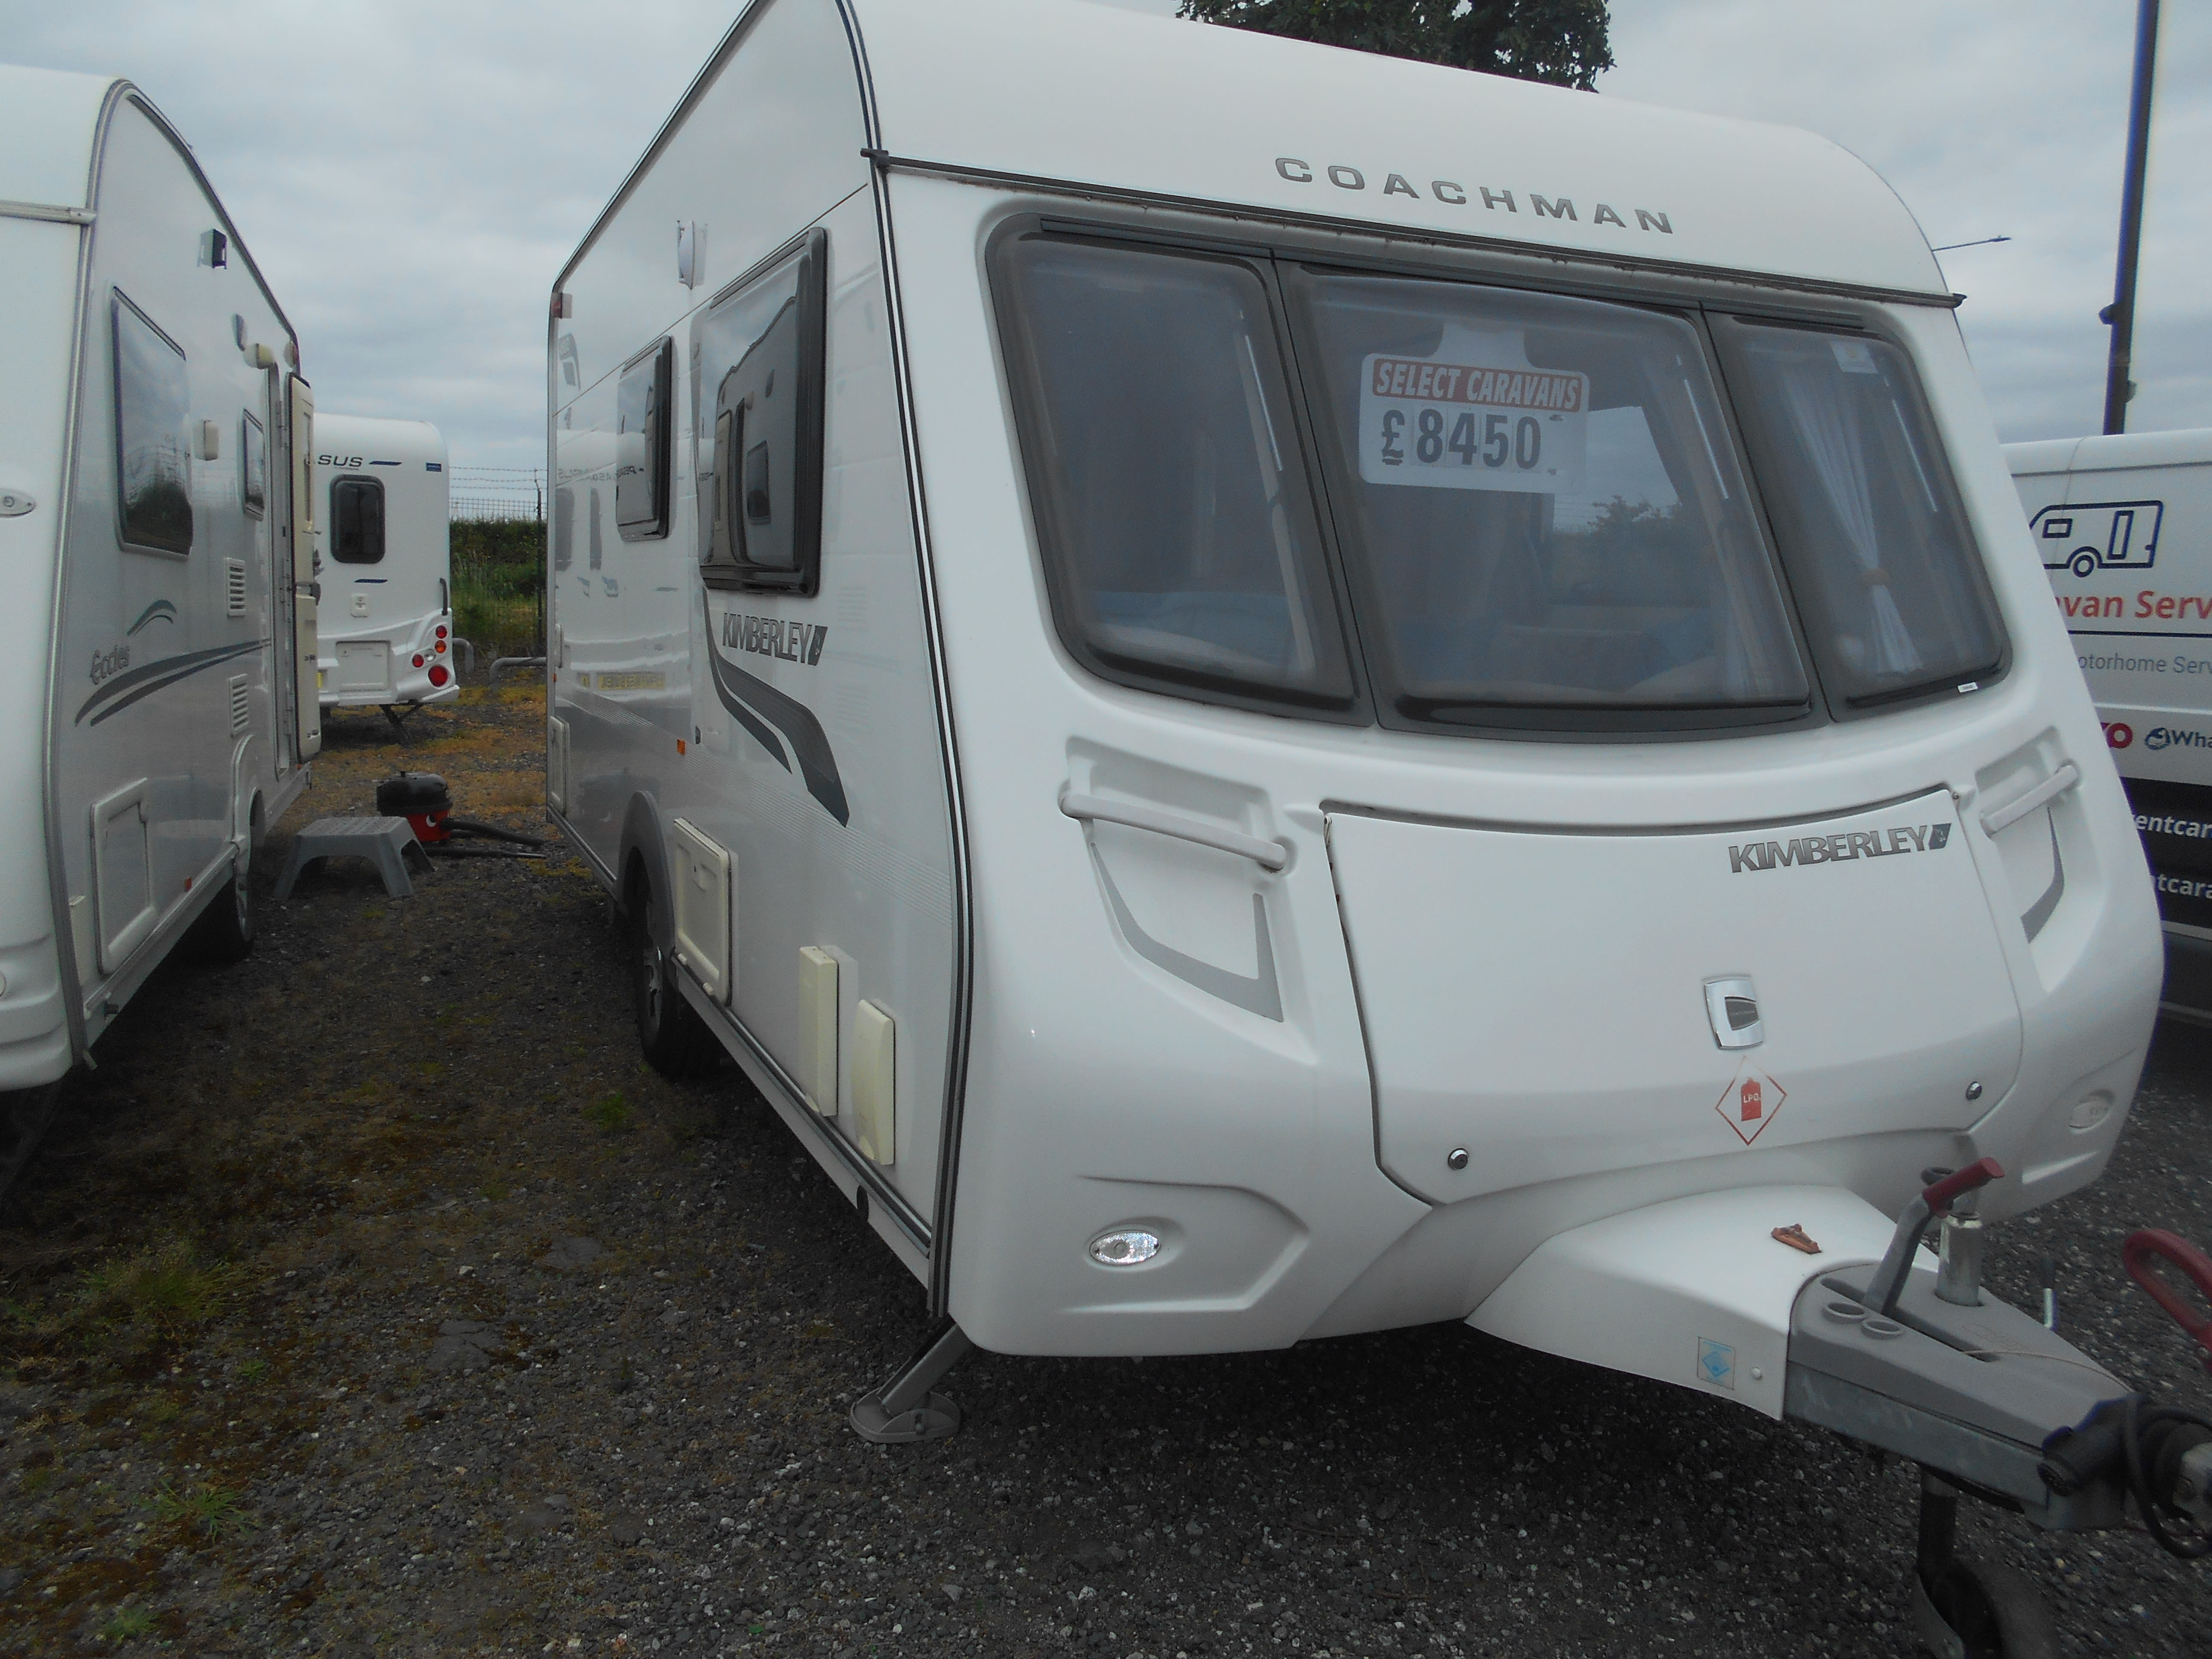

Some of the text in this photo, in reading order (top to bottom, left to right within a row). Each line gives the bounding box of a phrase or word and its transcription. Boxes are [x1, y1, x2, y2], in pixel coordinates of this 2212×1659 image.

[1275, 157, 1673, 234] COACHMAN
[1376, 362, 1579, 410] SELECT CARAVANS
[318, 455, 363, 467] SUS
[1381, 408, 1541, 469] £8450
[723, 612, 812, 664] KIMBERLEY
[1728, 825, 1927, 874] KIMBERLEY
[2132, 814, 2212, 838] entcar
